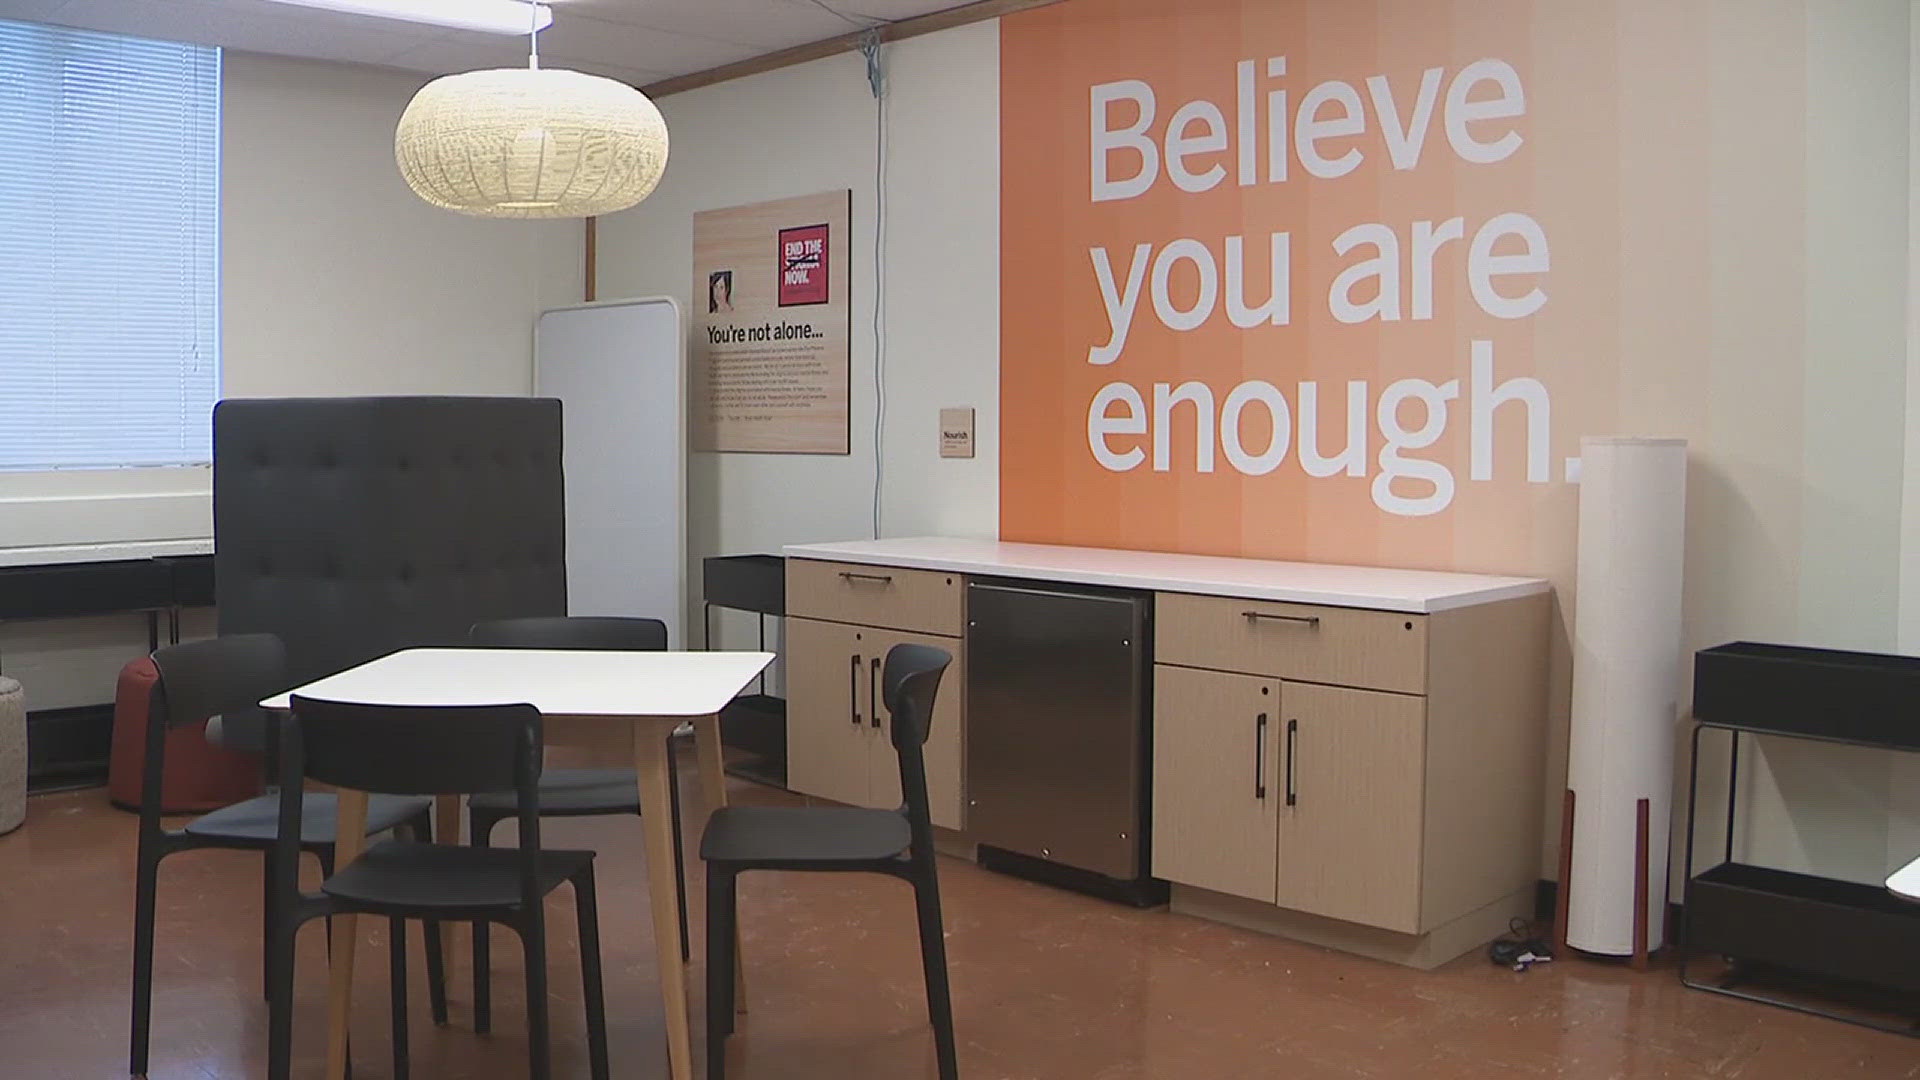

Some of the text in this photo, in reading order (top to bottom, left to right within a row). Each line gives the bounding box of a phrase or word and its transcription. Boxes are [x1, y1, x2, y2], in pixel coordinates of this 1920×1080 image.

[1090, 57, 1525, 202] Believe
[784, 269, 809, 286] NOW.
[785, 238, 822, 256] END THE
[1088, 213, 1550, 365] you are
[707, 319, 824, 345] You're not alone...
[1088, 340, 1580, 516] enough.
